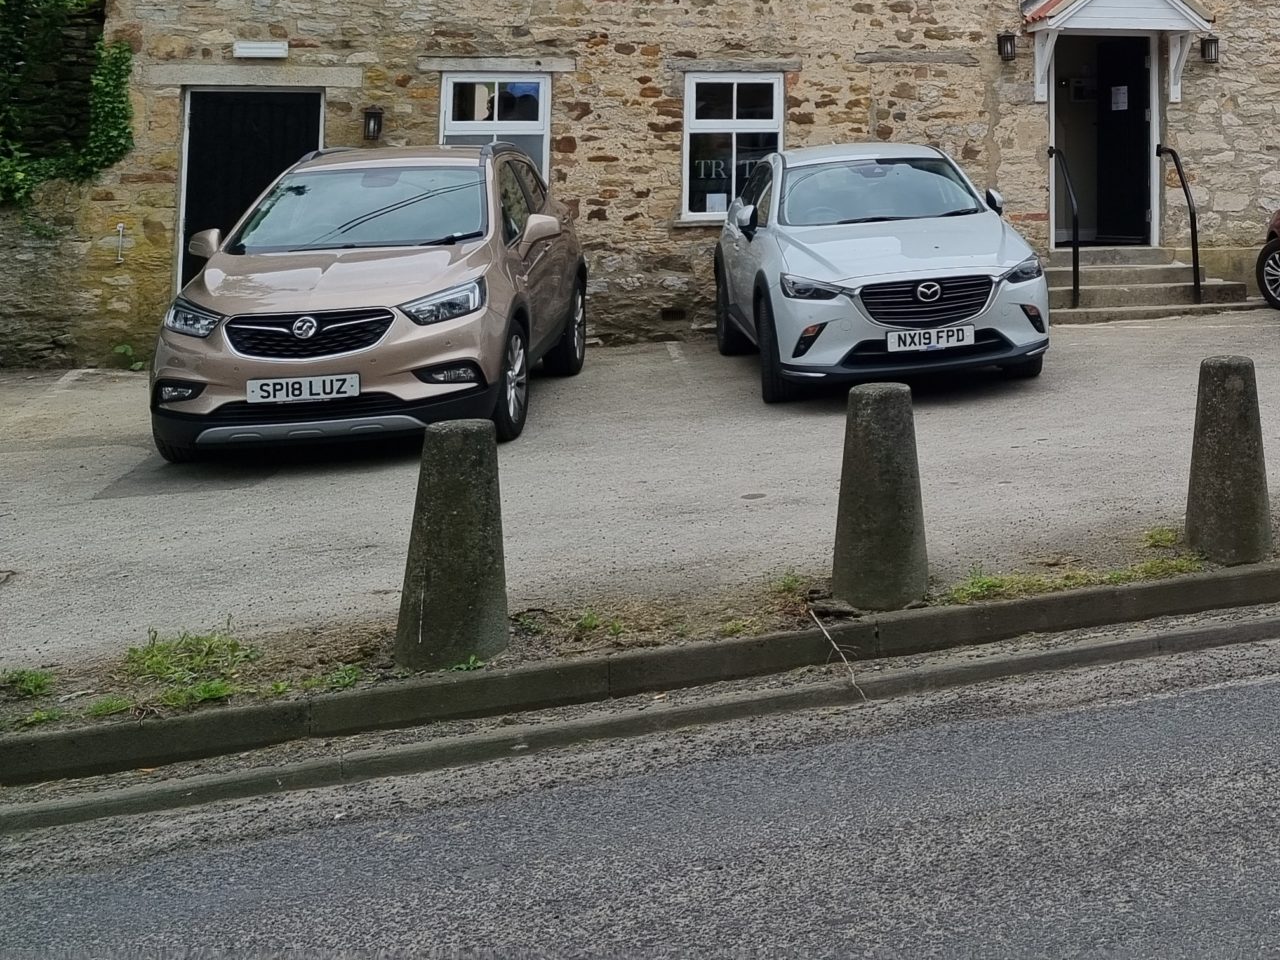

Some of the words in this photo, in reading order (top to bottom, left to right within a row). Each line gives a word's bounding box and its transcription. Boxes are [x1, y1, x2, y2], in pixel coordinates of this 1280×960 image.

[695, 159, 728, 179] TR
[898, 331, 932, 348] NX19
[936, 328, 965, 344] FPD
[260, 381, 303, 399] SP18
[309, 378, 347, 397] LUZ
